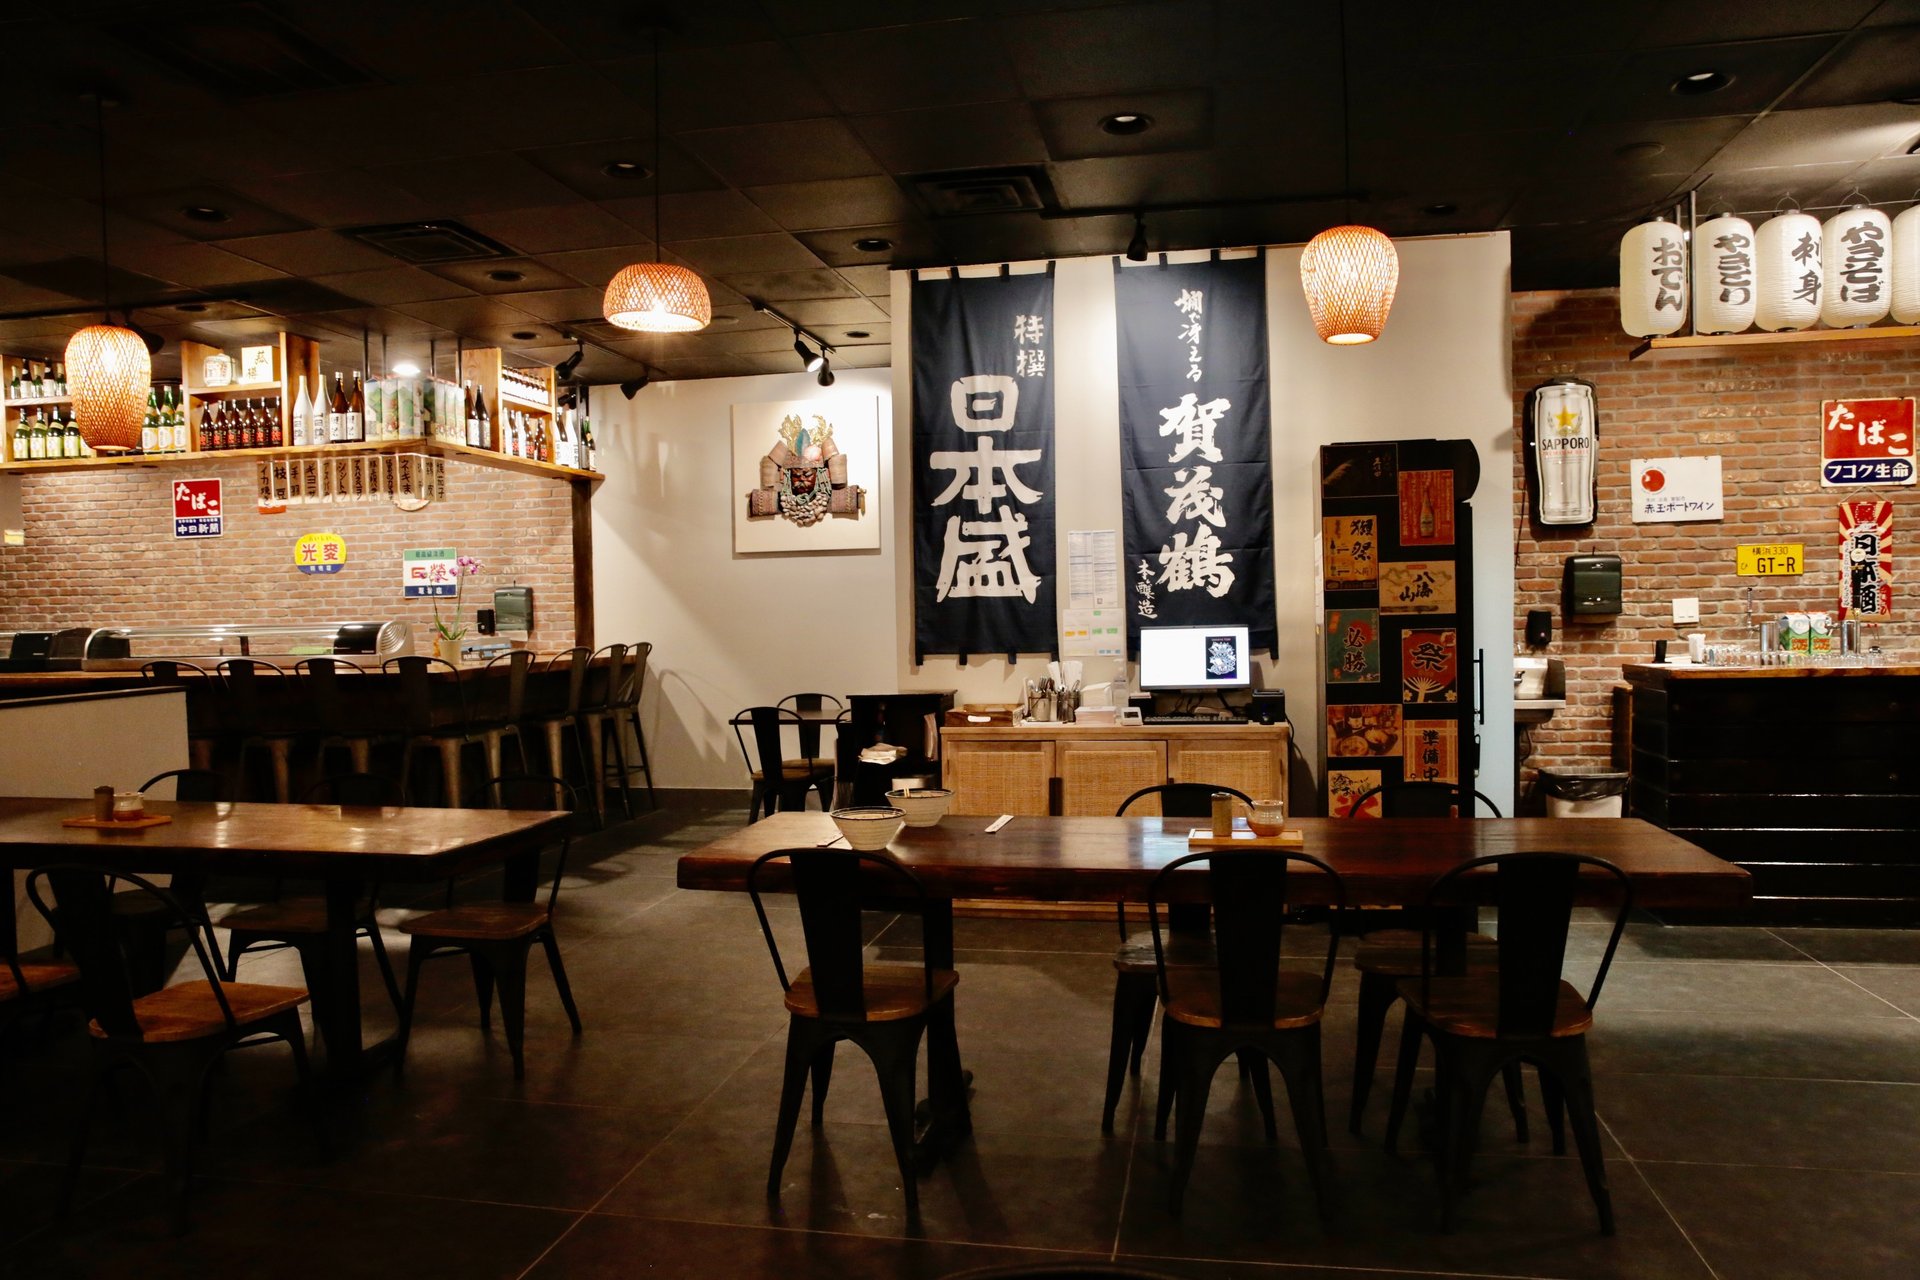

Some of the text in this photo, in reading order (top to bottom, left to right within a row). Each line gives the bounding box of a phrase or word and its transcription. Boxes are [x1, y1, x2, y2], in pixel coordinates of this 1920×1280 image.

[1651, 237, 1683, 311] おでん
[1714, 233, 1751, 306] やきとり
[1791, 231, 1823, 306] 刺身
[1839, 221, 1885, 304] やきそば
[1013, 314, 1046, 378] 特撰
[1541, 437, 1590, 451] SAPPORO
[1827, 403, 1910, 456] たばこ
[274, 466, 287, 500] 枝豆
[290, 466, 300, 496] 手羽
[929, 373, 1044, 605] 日本盛
[1827, 462, 1910, 479] フコク生命
[176, 482, 219, 516] たばこ
[1155, 392, 1236, 599] 賀茂鶴
[1644, 501, 1715, 514] 赤玉ポートワイン
[177, 522, 220, 535] 中日新聞
[1757, 556, 1796, 573] GT-R
[1772, 546, 1789, 555] 330
[1343, 627, 1367, 673] 必勝
[1409, 642, 1452, 673] 祭
[1422, 729, 1440, 783] 準備中
